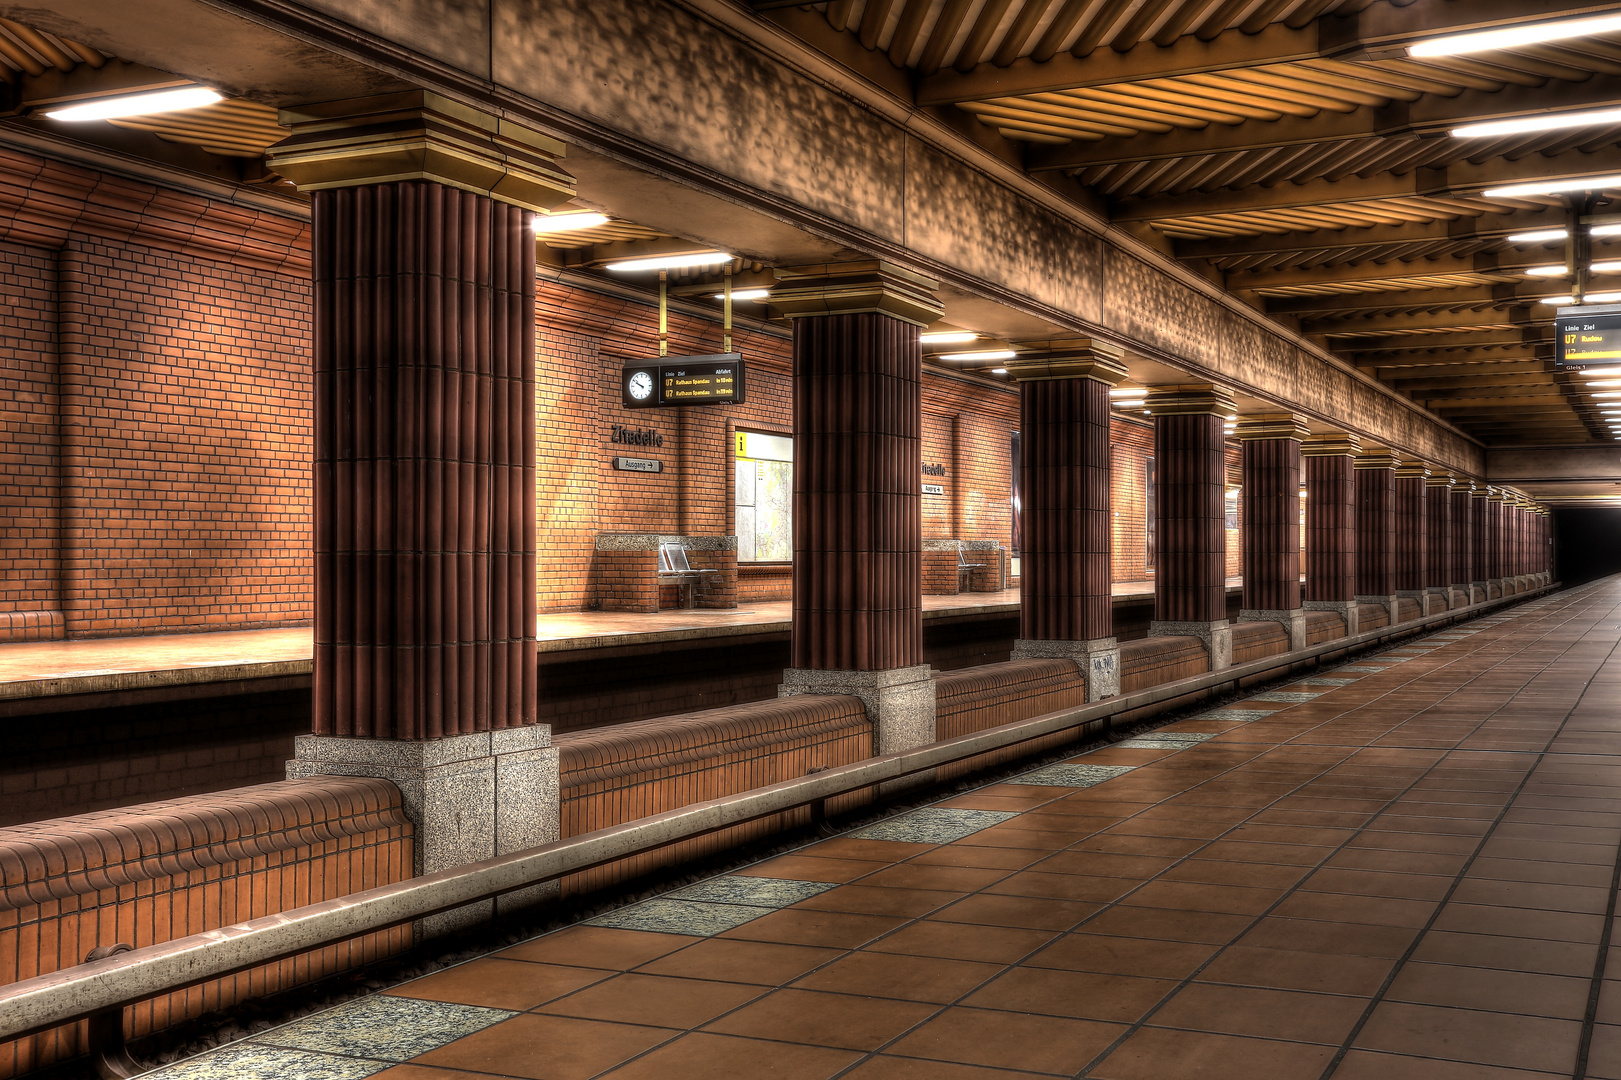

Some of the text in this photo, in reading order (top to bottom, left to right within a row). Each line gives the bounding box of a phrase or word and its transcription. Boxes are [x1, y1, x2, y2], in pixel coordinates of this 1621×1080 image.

[1565, 335, 1576, 344] U7
[612, 425, 663, 447] Zitadelle
[626, 460, 645, 470] Ausgang
